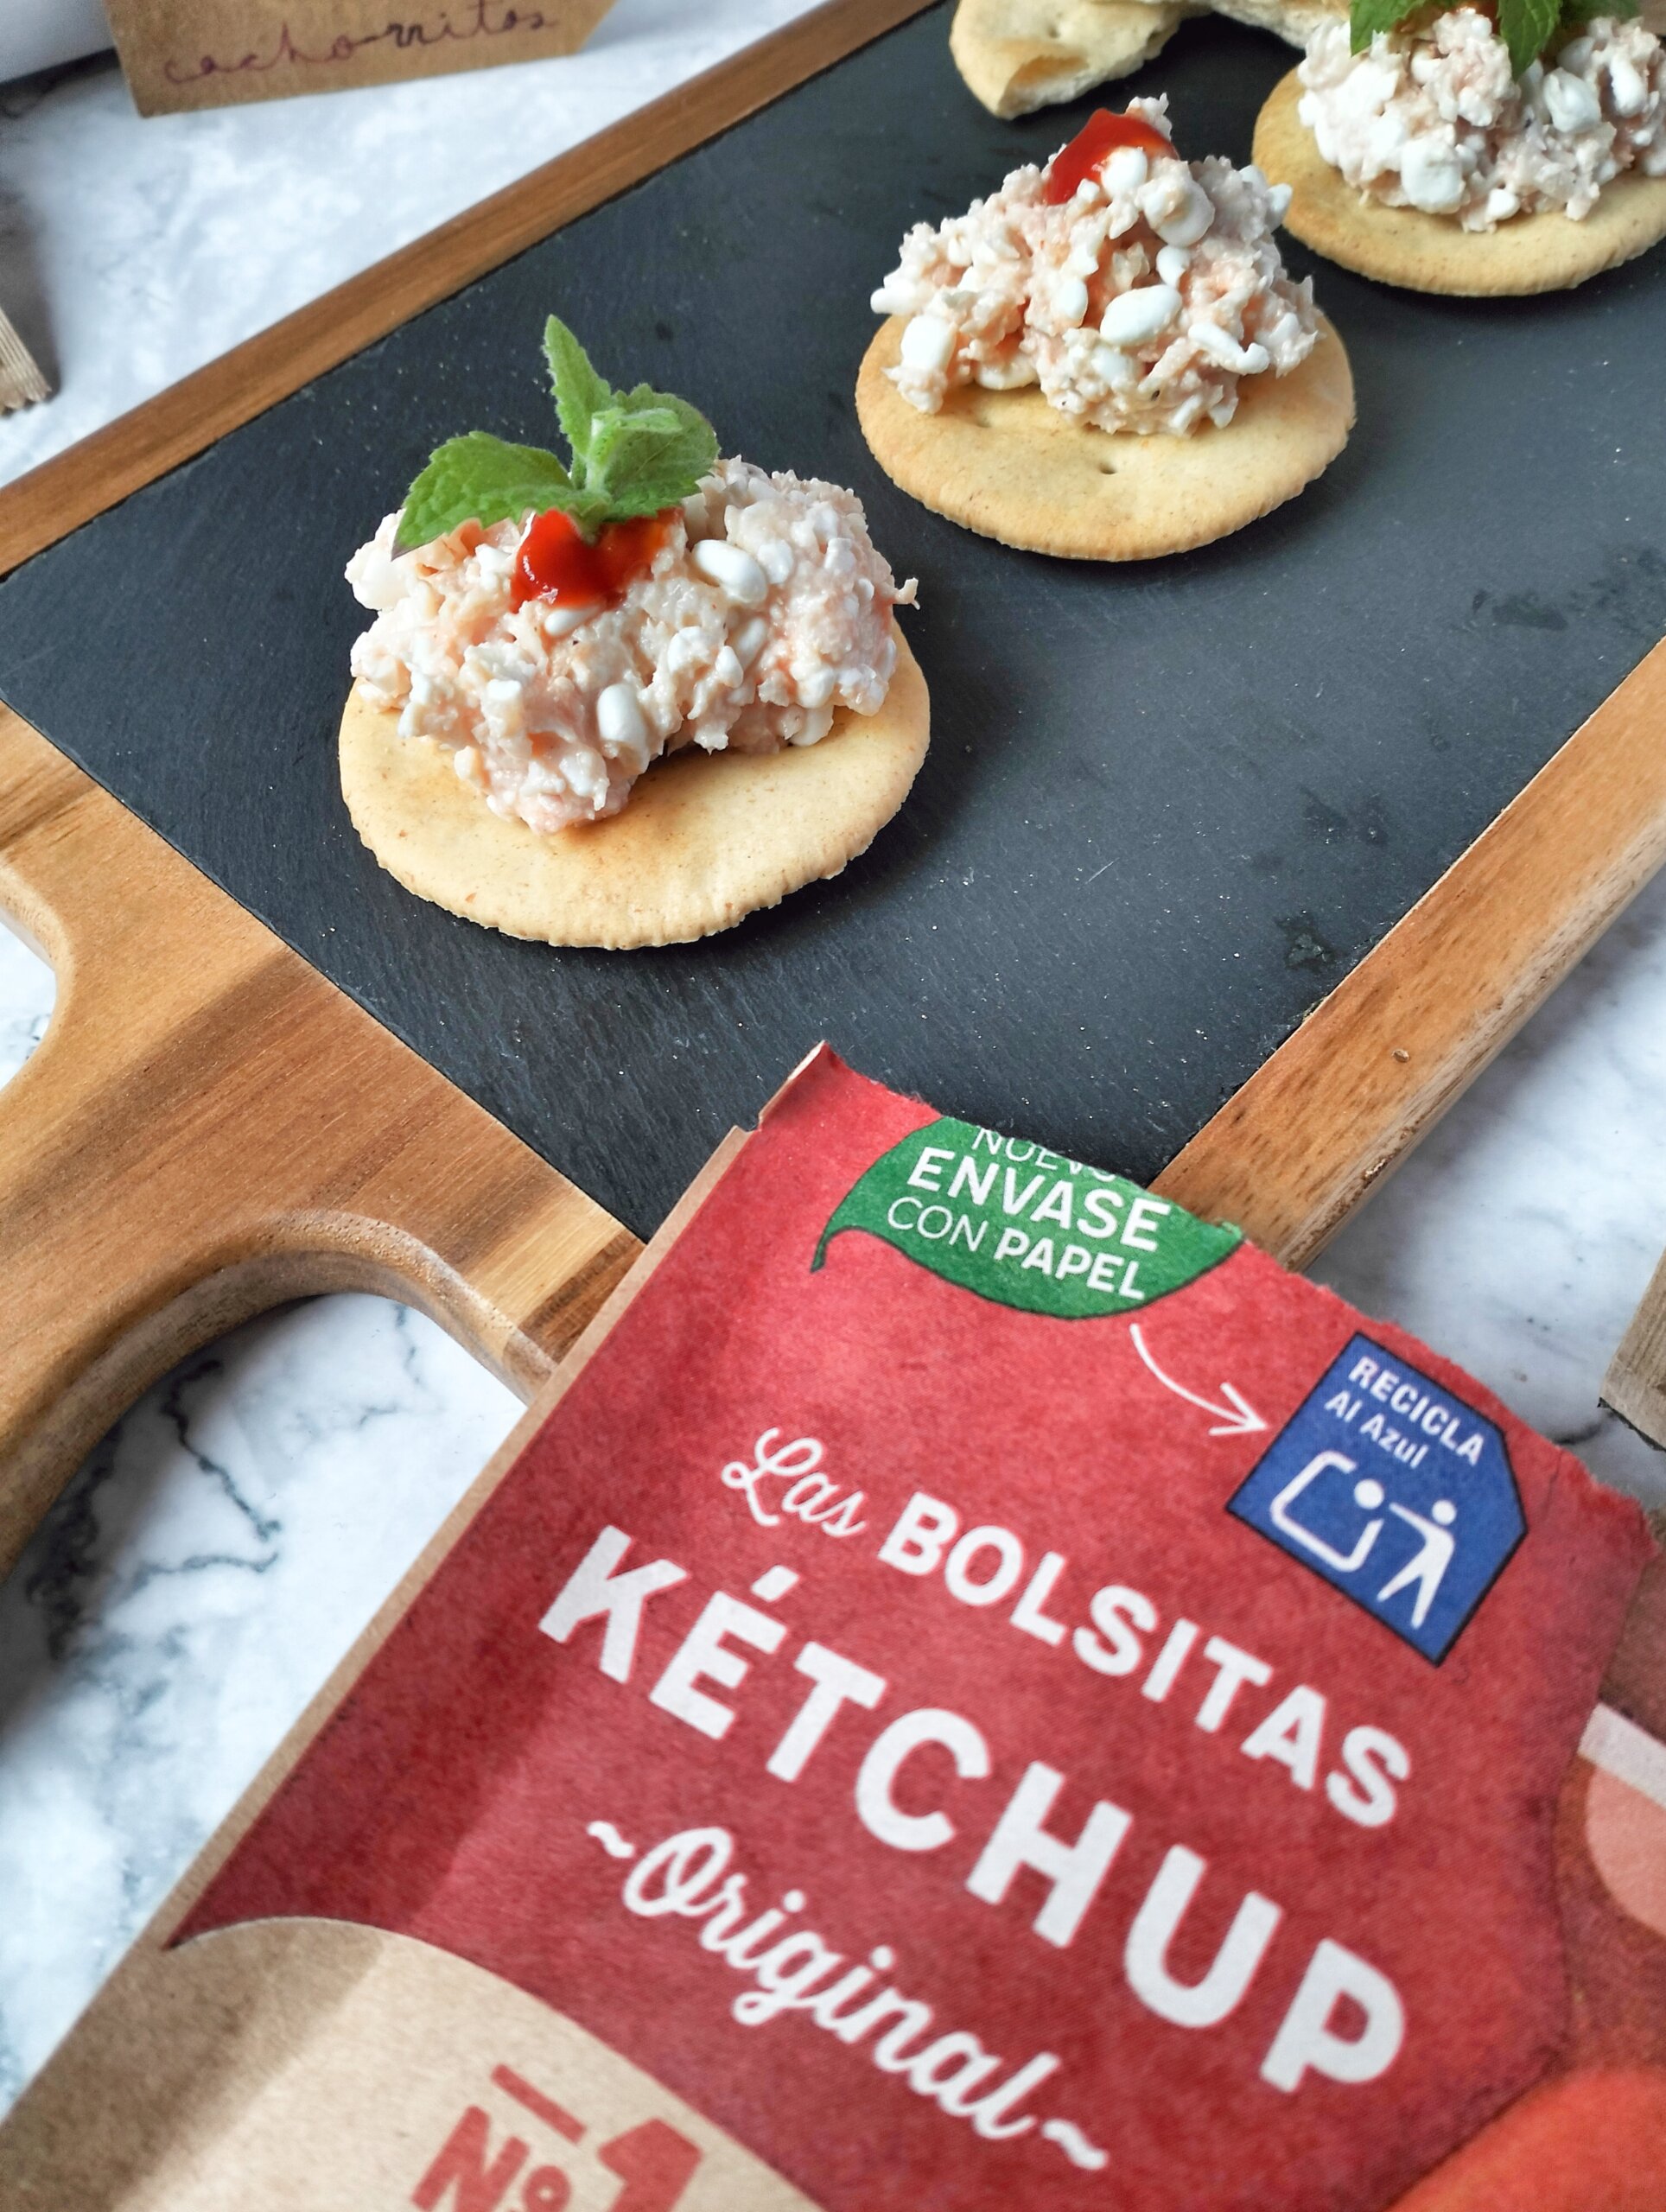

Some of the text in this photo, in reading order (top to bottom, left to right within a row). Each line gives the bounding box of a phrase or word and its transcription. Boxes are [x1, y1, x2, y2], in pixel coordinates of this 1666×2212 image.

[887, 1196, 1146, 1301] CON PAPEL
[906, 1146, 1172, 1253] ENVASE
[1324, 1389, 1429, 1467] Al Azul
[1348, 1355, 1485, 1465] RECICLA
[721, 1427, 1410, 1827] Las BOLSITAS
[538, 1524, 1404, 2093] KÉTCHUP
